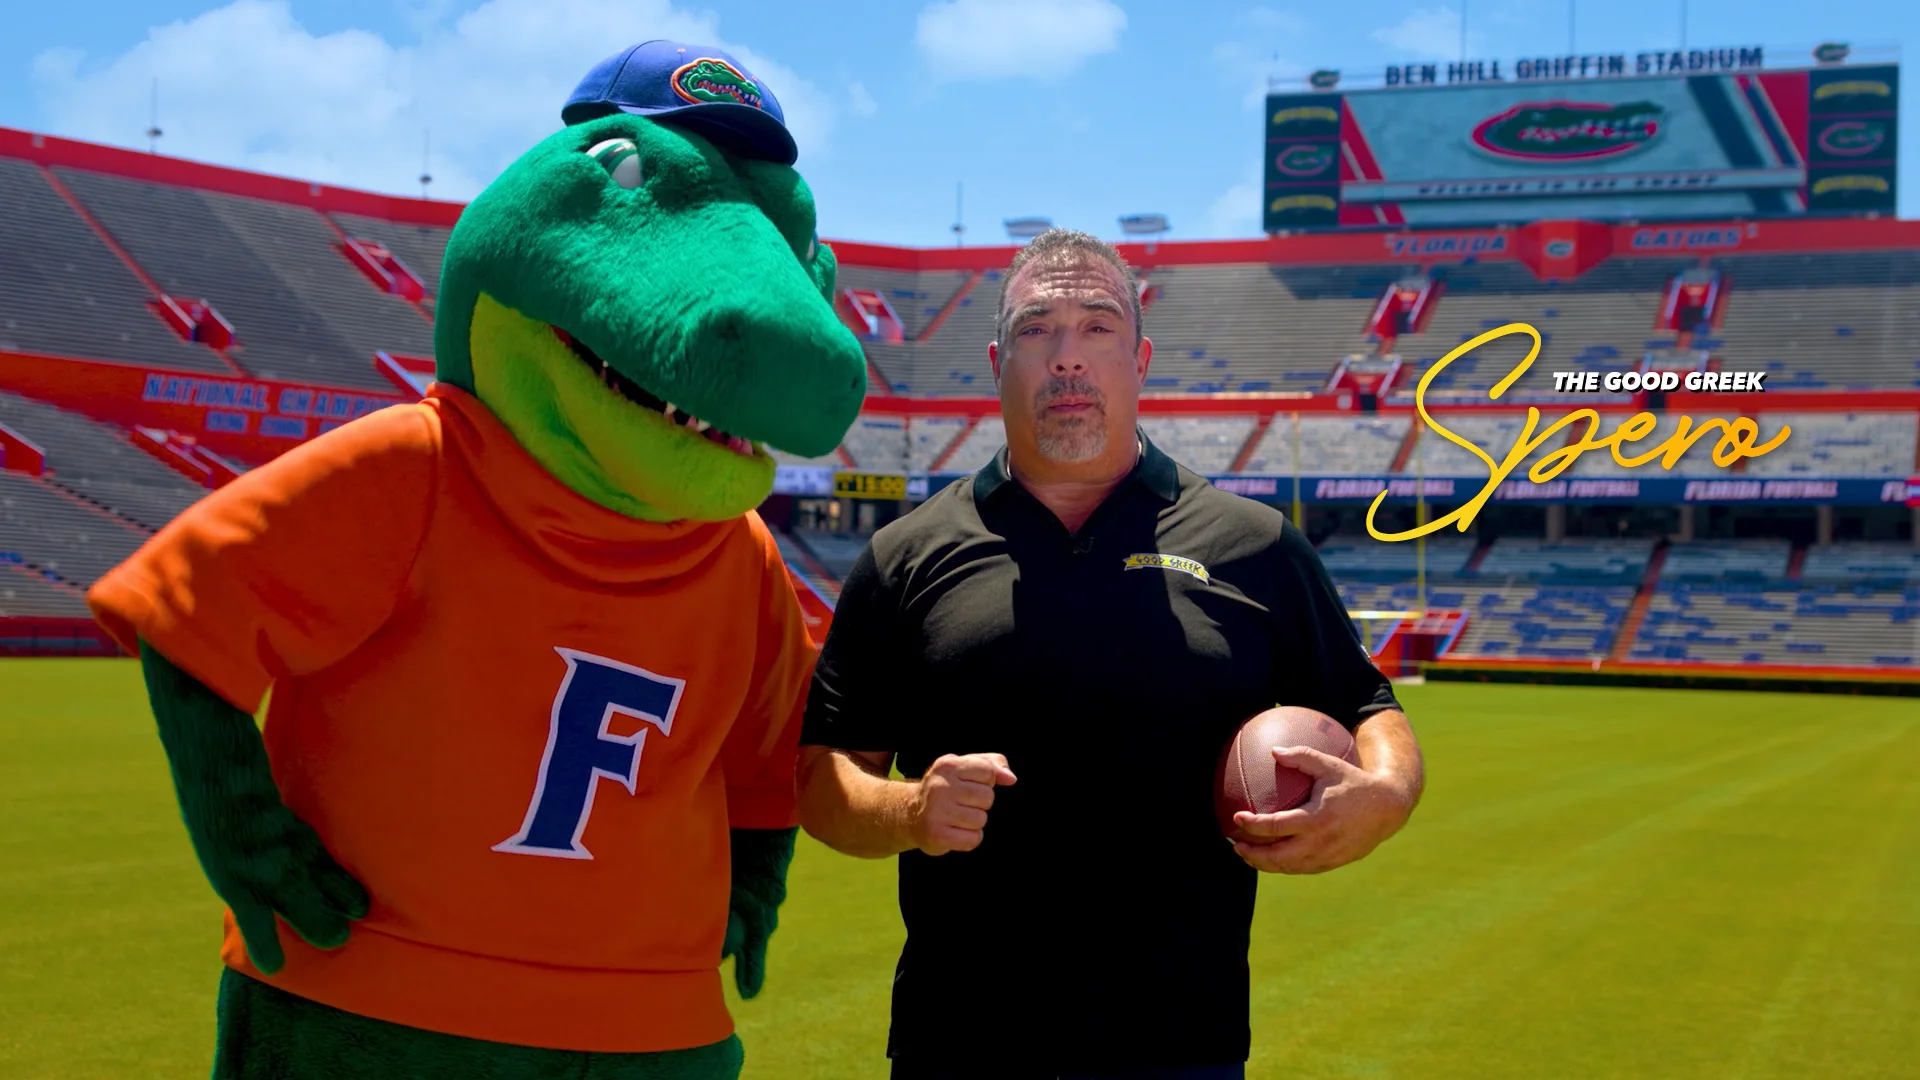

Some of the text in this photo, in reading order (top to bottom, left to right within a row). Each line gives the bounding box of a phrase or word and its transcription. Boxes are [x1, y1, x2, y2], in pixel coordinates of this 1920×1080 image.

[1385, 46, 1763, 85] BEN HILL GRIFFIN STADIUM
[1391, 227, 1742, 257] FLORIDA GATORS
[142, 373, 270, 412] NATIONAL
[1567, 480, 1640, 497] FOOTBALL
[1684, 480, 1838, 500] FLORIDA FOOTBALL
[1135, 555, 1202, 573] GOOD GREEK
[490, 645, 687, 861] F
